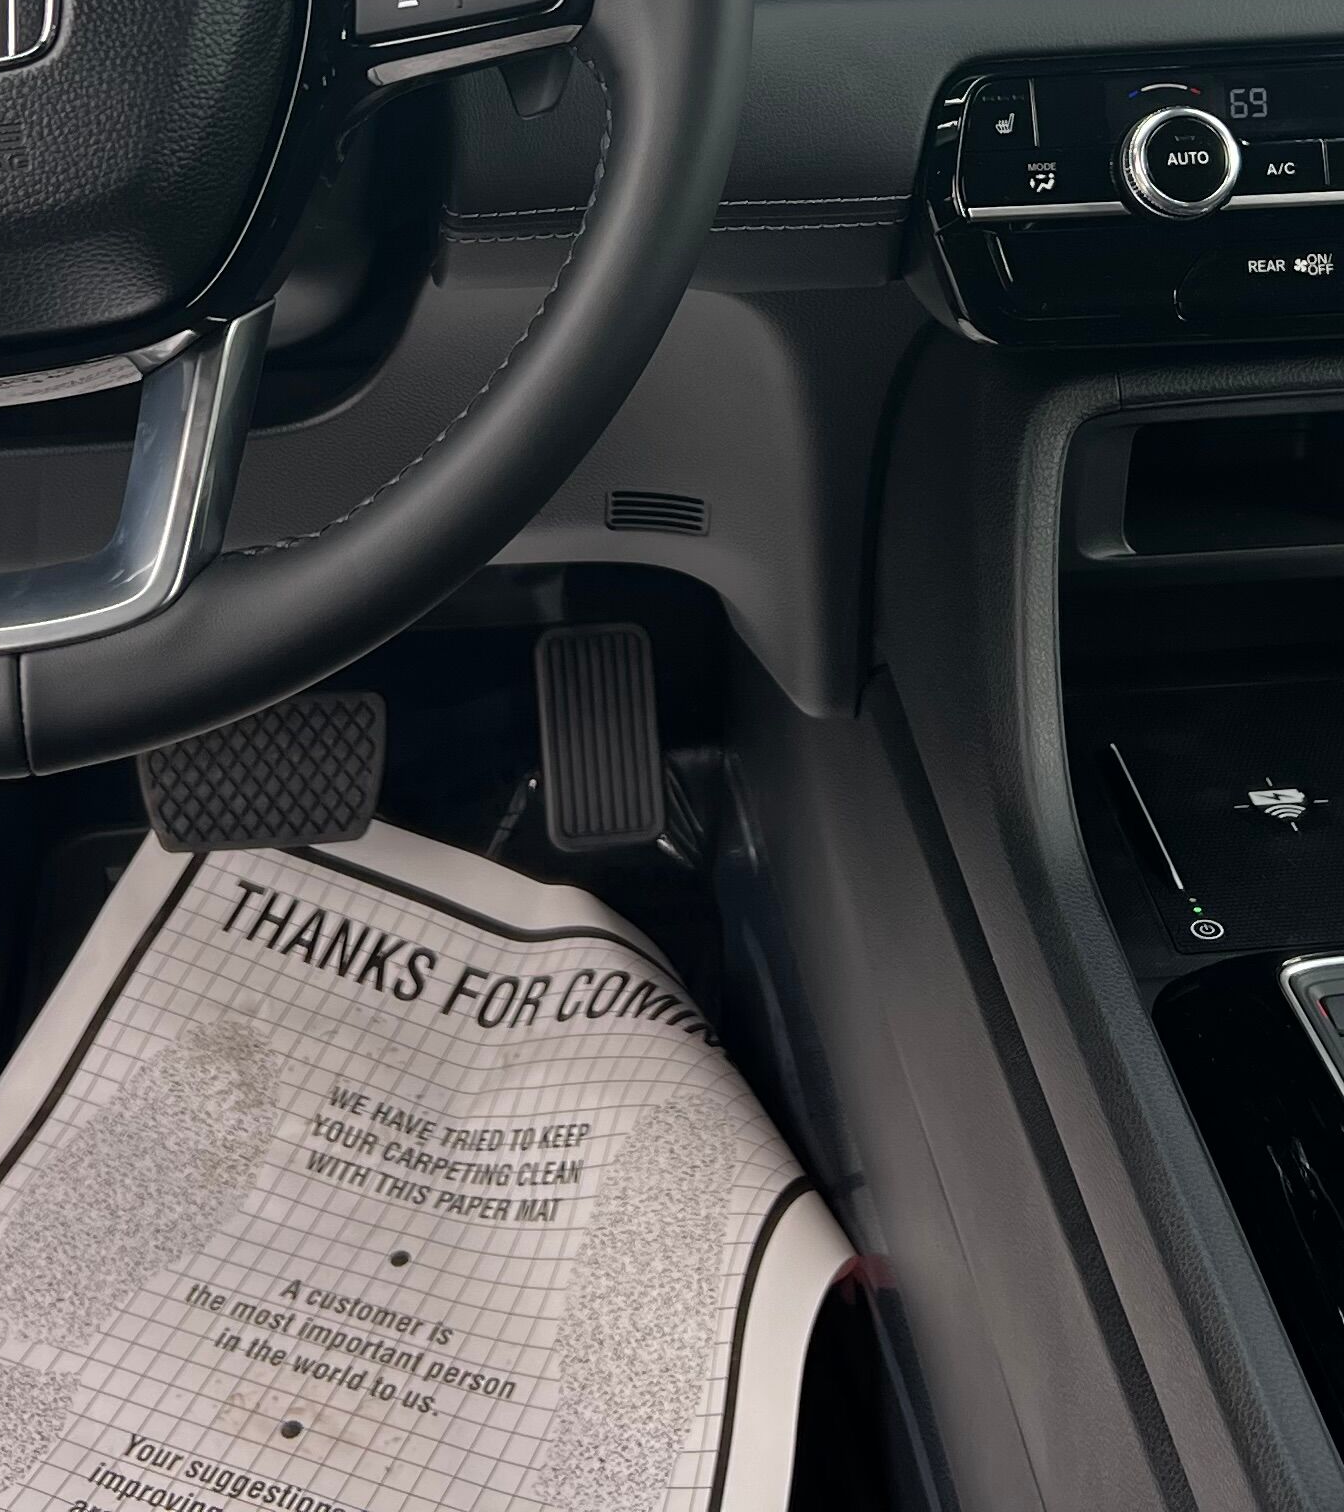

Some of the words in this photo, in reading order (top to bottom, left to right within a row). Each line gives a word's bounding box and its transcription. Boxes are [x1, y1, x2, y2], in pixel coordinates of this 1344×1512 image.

[1230, 88, 1268, 119] 69
[1027, 162, 1057, 172] MODE
[1167, 149, 1210, 167] AUTO
[1266, 162, 1296, 176] A/C
[1248, 259, 1286, 273] REAR
[1307, 263, 1334, 276] OFF
[222, 880, 438, 1002] THANKS
[440, 966, 552, 1028] FOR
[311, 1113, 379, 1155] YOUR
[383, 1141, 513, 1186] CARPETING
[516, 1159, 584, 1186] CLEAN
[328, 1086, 371, 1116] WE
[370, 1101, 437, 1142] HAVE
[440, 1127, 506, 1151] TRIED
[507, 1128, 536, 1150] TO
[538, 1123, 592, 1149] KEEP
[306, 1150, 373, 1187] WITH
[374, 1171, 432, 1205] THIS
[433, 1191, 511, 1221] PAPER
[514, 1197, 563, 1222] MAT
[185, 1283, 225, 1311] the
[230, 1299, 295, 1334] most
[297, 1317, 423, 1373] important
[423, 1358, 517, 1400] person
[279, 1279, 303, 1300] A
[306, 1287, 424, 1337] customer
[427, 1320, 454, 1346] is
[215, 1327, 240, 1353] in
[245, 1338, 287, 1366] the
[293, 1354, 368, 1390] world
[370, 1377, 397, 1401] to
[401, 1393, 439, 1417] us.
[122, 1433, 184, 1472] Your
[185, 1459, 347, 1512] suggestion
